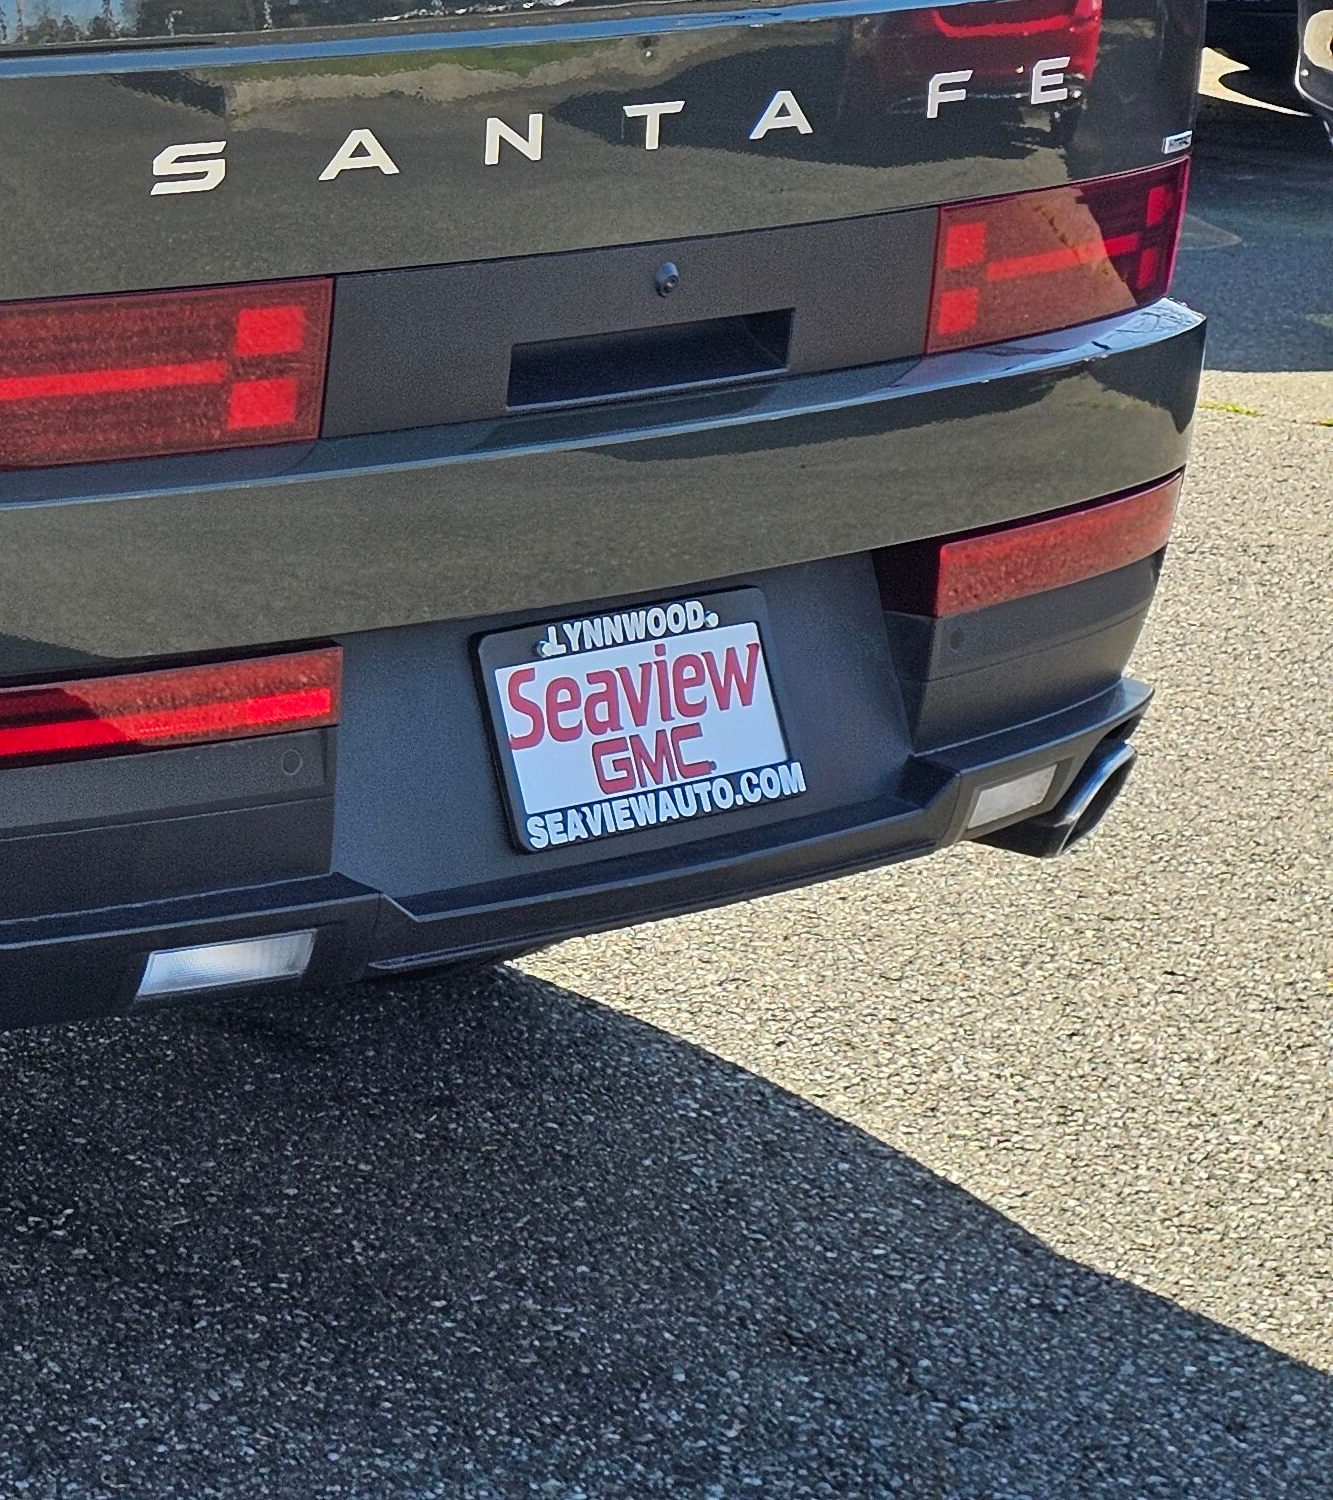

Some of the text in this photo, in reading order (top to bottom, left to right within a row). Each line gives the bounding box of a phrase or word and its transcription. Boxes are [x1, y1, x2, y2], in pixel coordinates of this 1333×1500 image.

[150, 56, 1071, 196] SANTA FE
[507, 642, 760, 751] Seaview
[526, 761, 807, 849] SEAVIEWAUTO.COM
[591, 722, 714, 795] GMC
